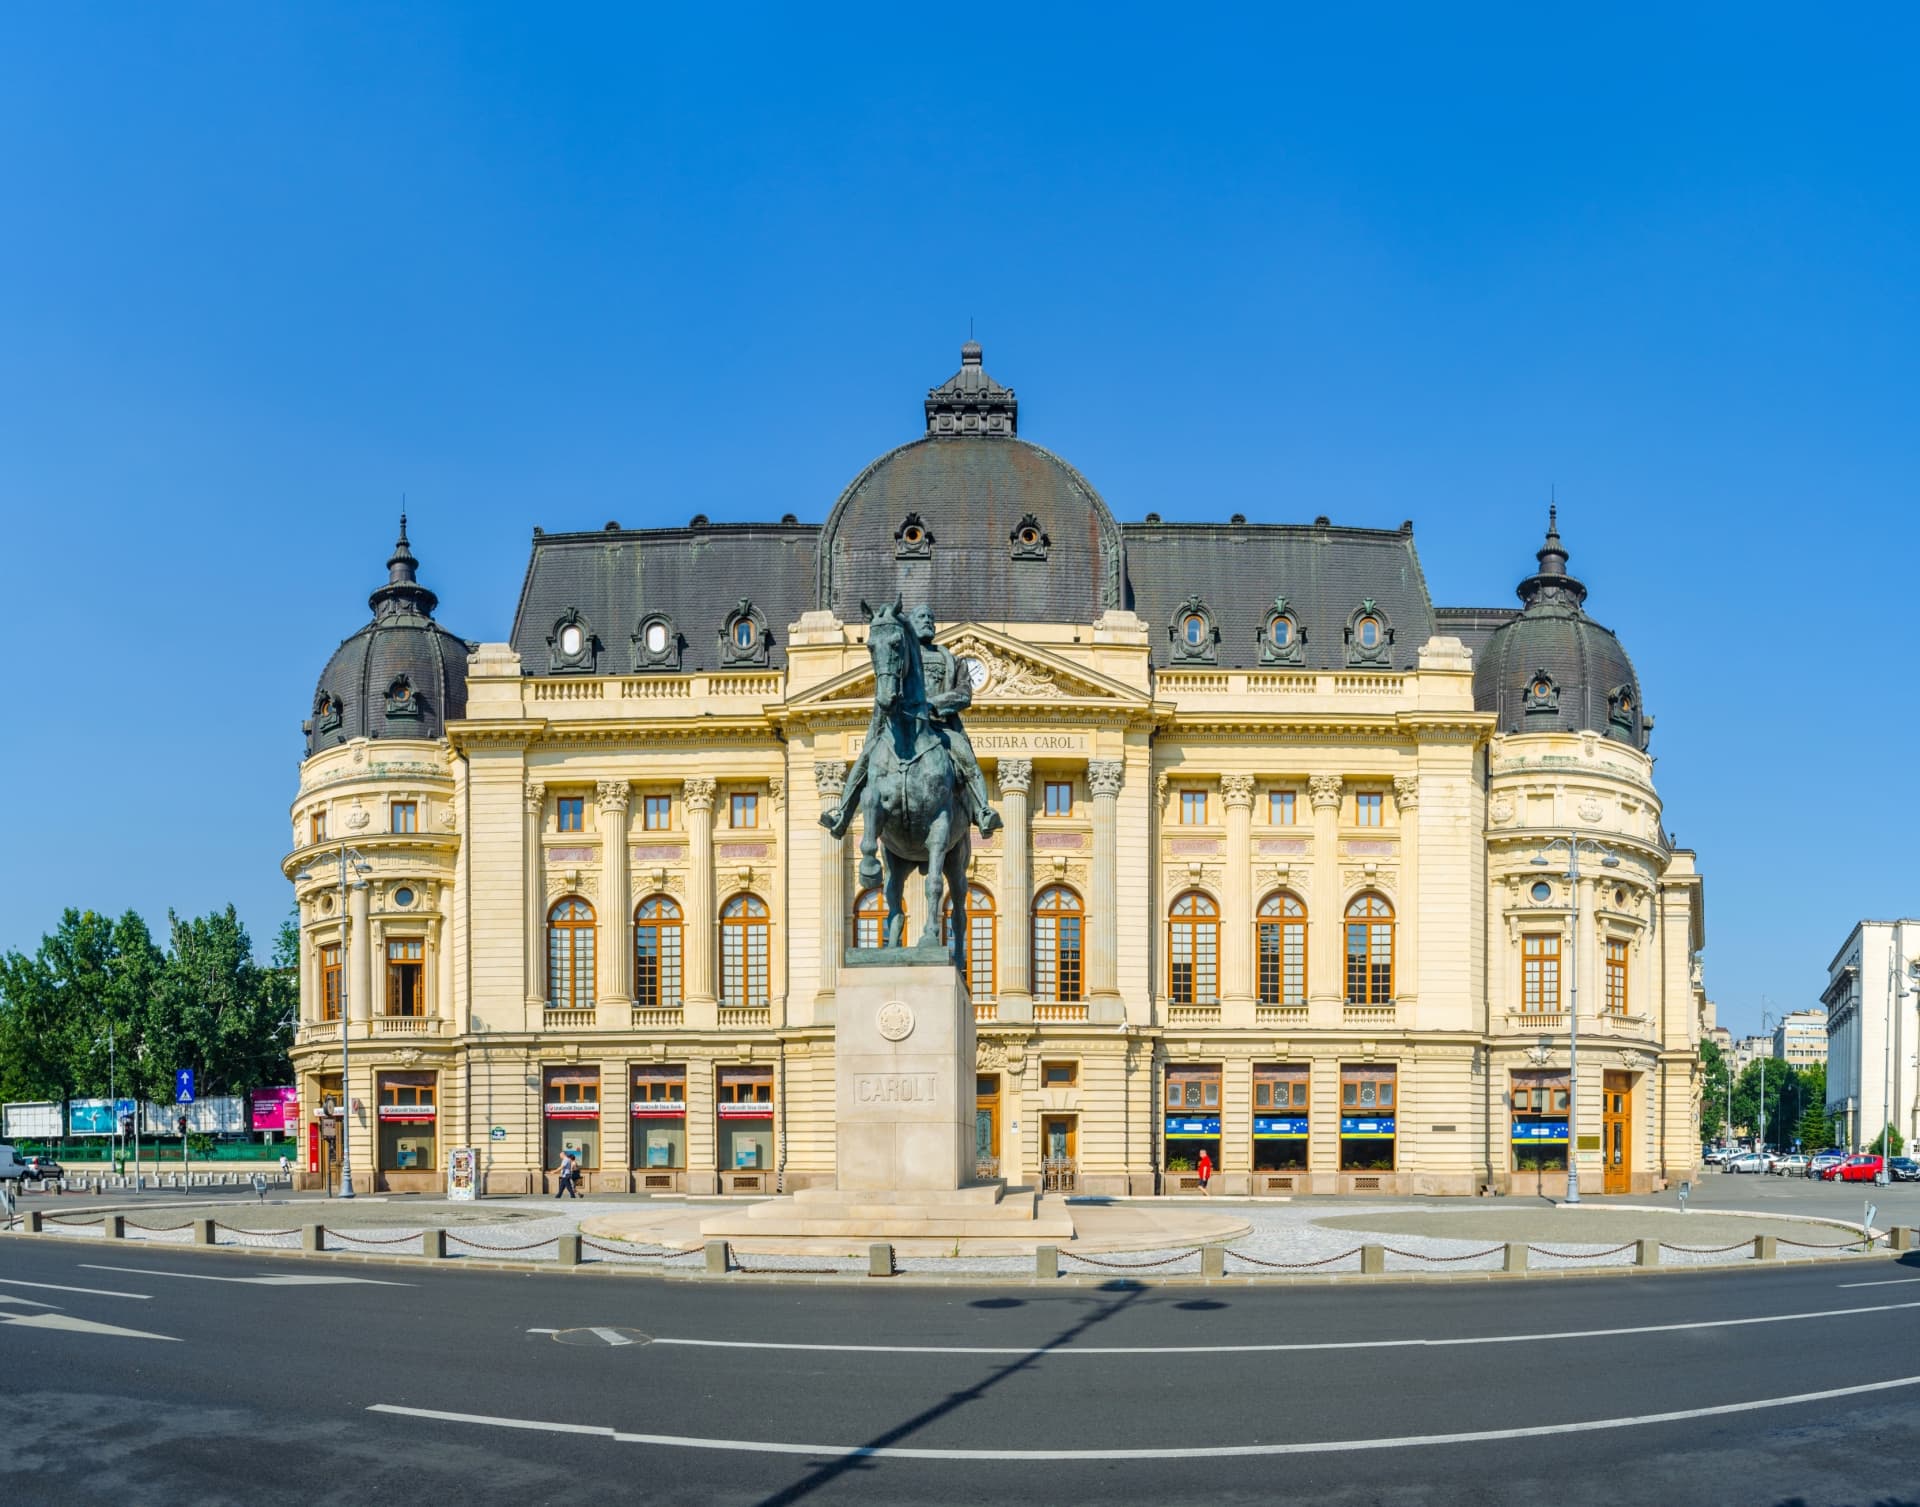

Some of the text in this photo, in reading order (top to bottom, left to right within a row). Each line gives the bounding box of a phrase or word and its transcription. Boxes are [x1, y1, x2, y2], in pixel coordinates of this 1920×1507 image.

[969, 736, 1029, 749] ERSITARA
[1034, 736, 1075, 750] CAROL
[859, 1077, 936, 1102] CAROL I
